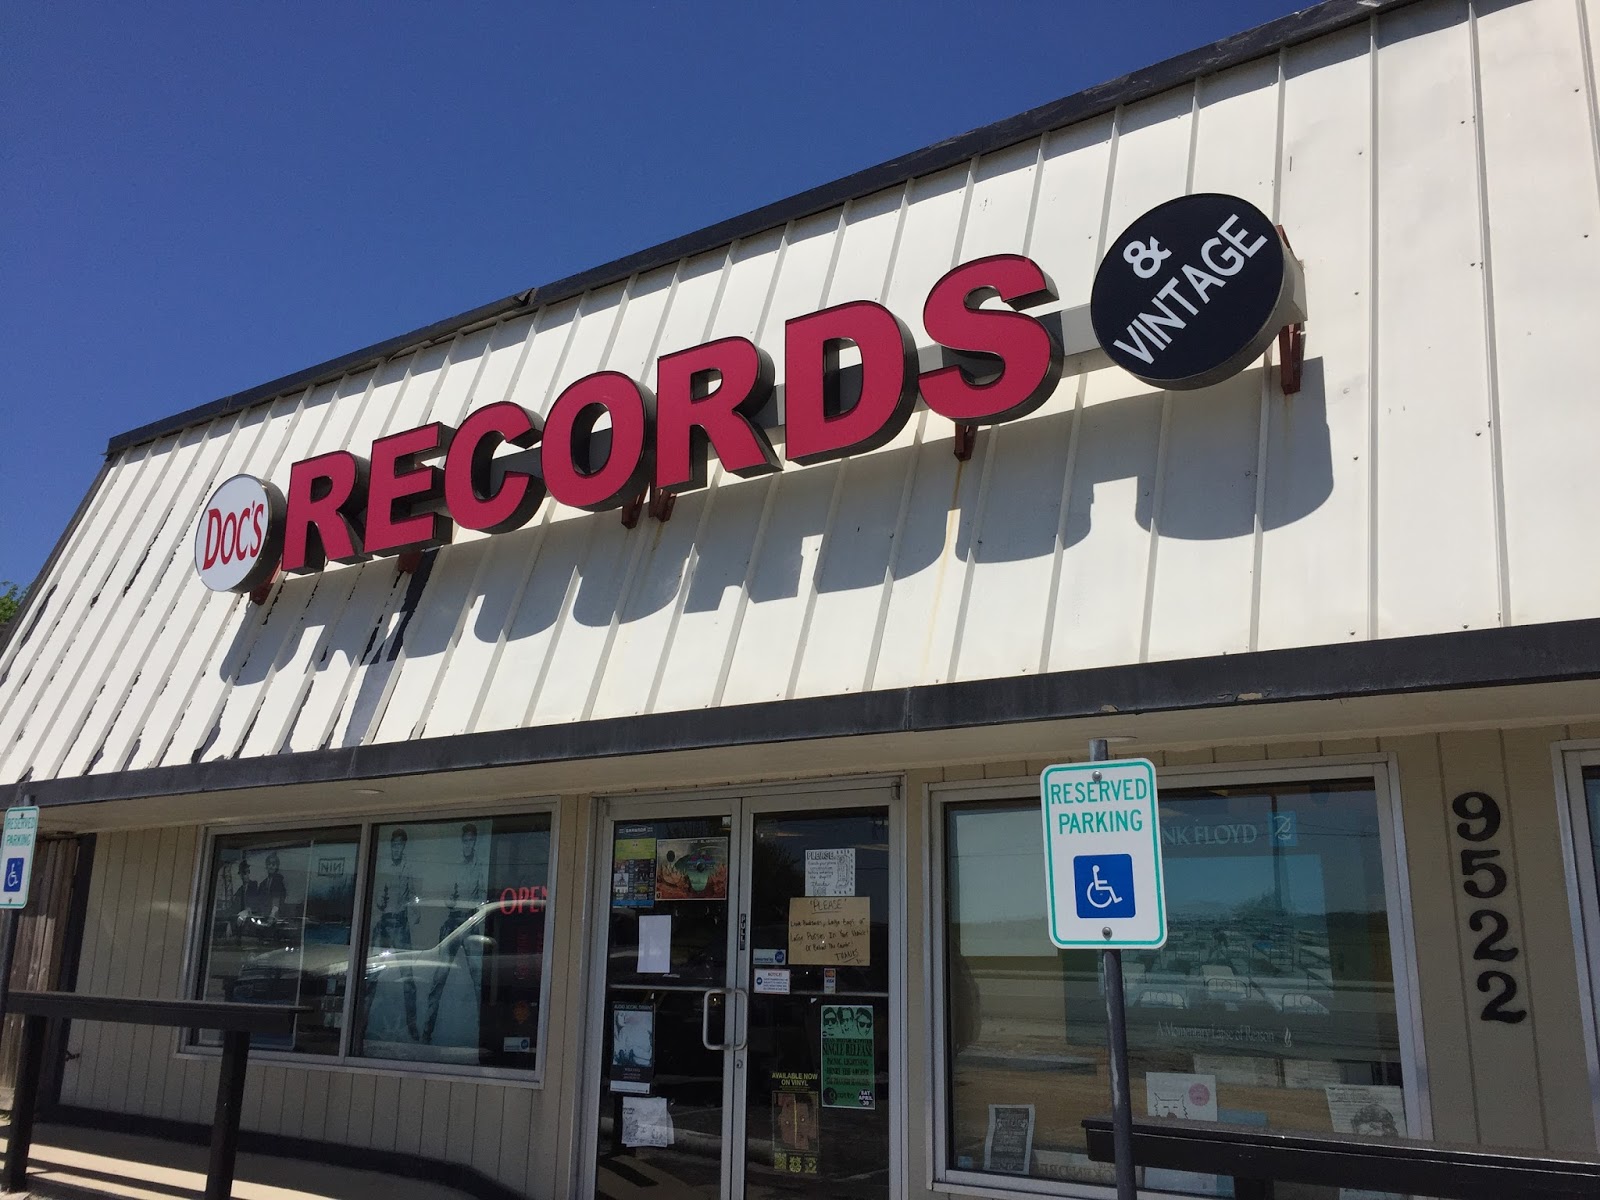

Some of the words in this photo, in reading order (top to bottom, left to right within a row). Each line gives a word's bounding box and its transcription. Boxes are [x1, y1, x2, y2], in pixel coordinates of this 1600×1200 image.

[1123, 235, 1172, 279] &
[1112, 213, 1268, 365] VINTAGE
[281, 253, 1062, 573] RECORDS
[202, 500, 264, 570] DOC'S
[1050, 778, 1147, 805] RESERVED
[1058, 809, 1143, 834] PARKING
[1161, 826, 1190, 846] NK
[1195, 824, 1257, 844] FLOYD
[1452, 791, 1527, 1024] 9522
[771, 1072, 802, 1080] AVAILABLE
